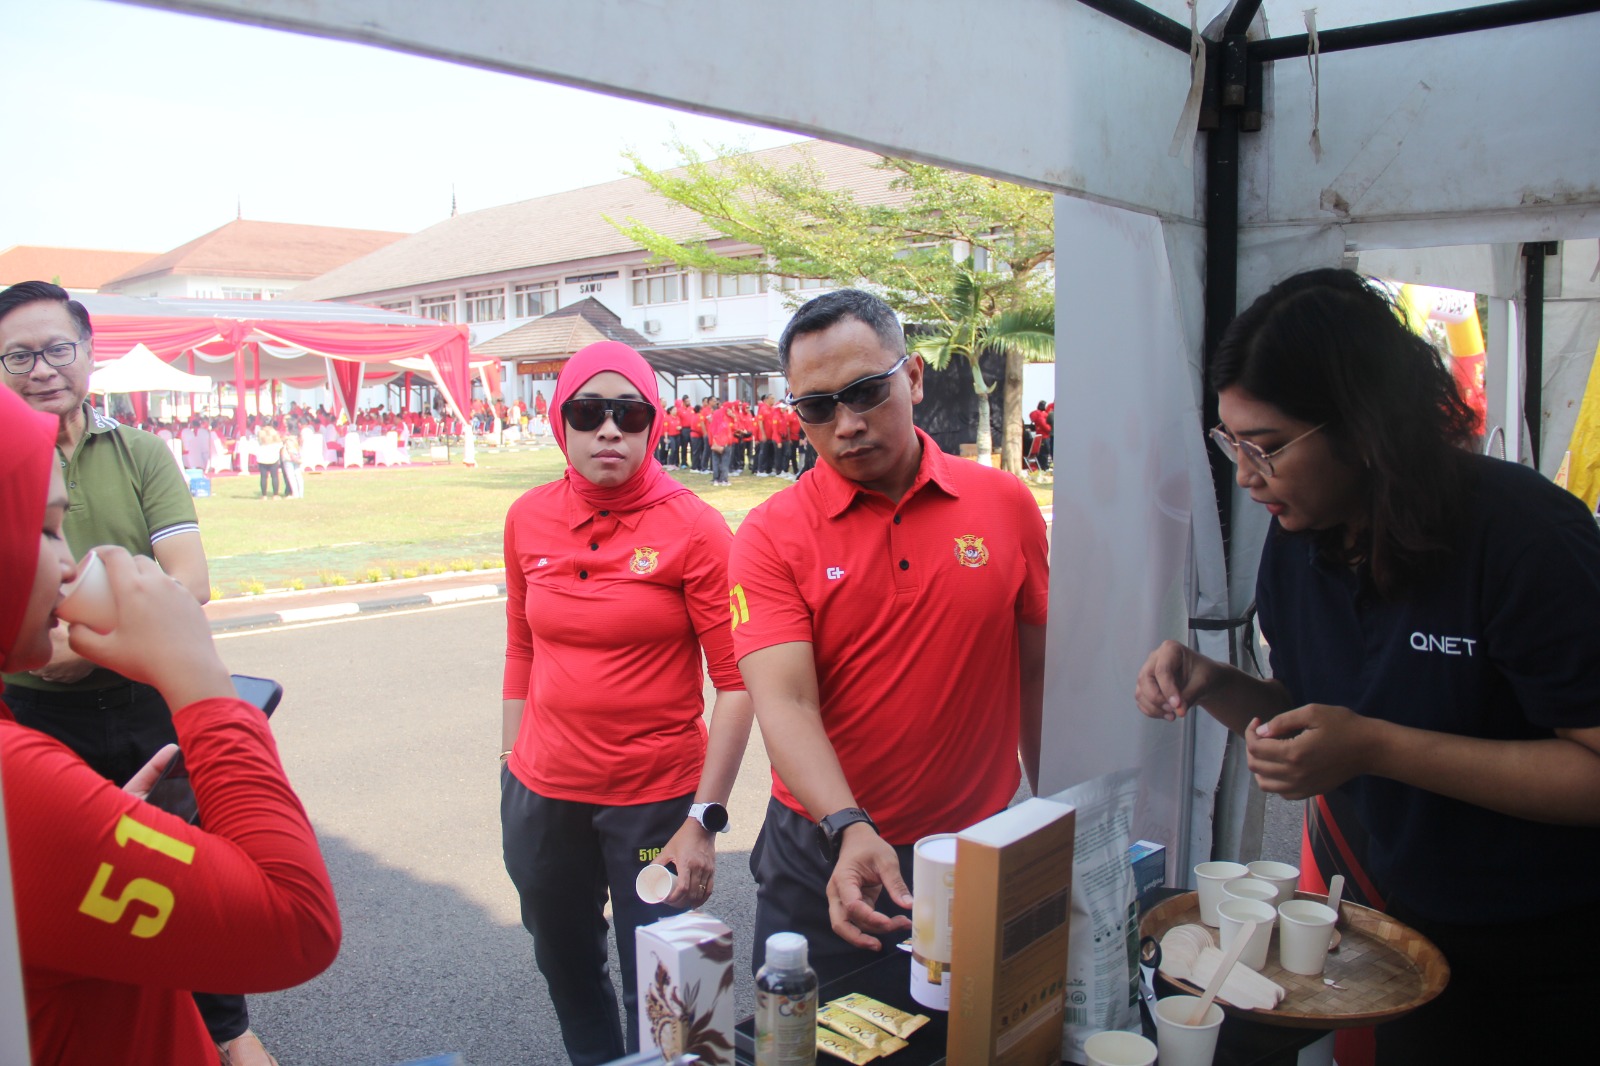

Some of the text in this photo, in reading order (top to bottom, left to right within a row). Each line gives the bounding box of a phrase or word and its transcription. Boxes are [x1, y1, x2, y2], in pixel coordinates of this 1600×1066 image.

[580, 283, 602, 294] SAWU
[1409, 631, 1477, 657] QNET
[78, 813, 196, 938] 51
